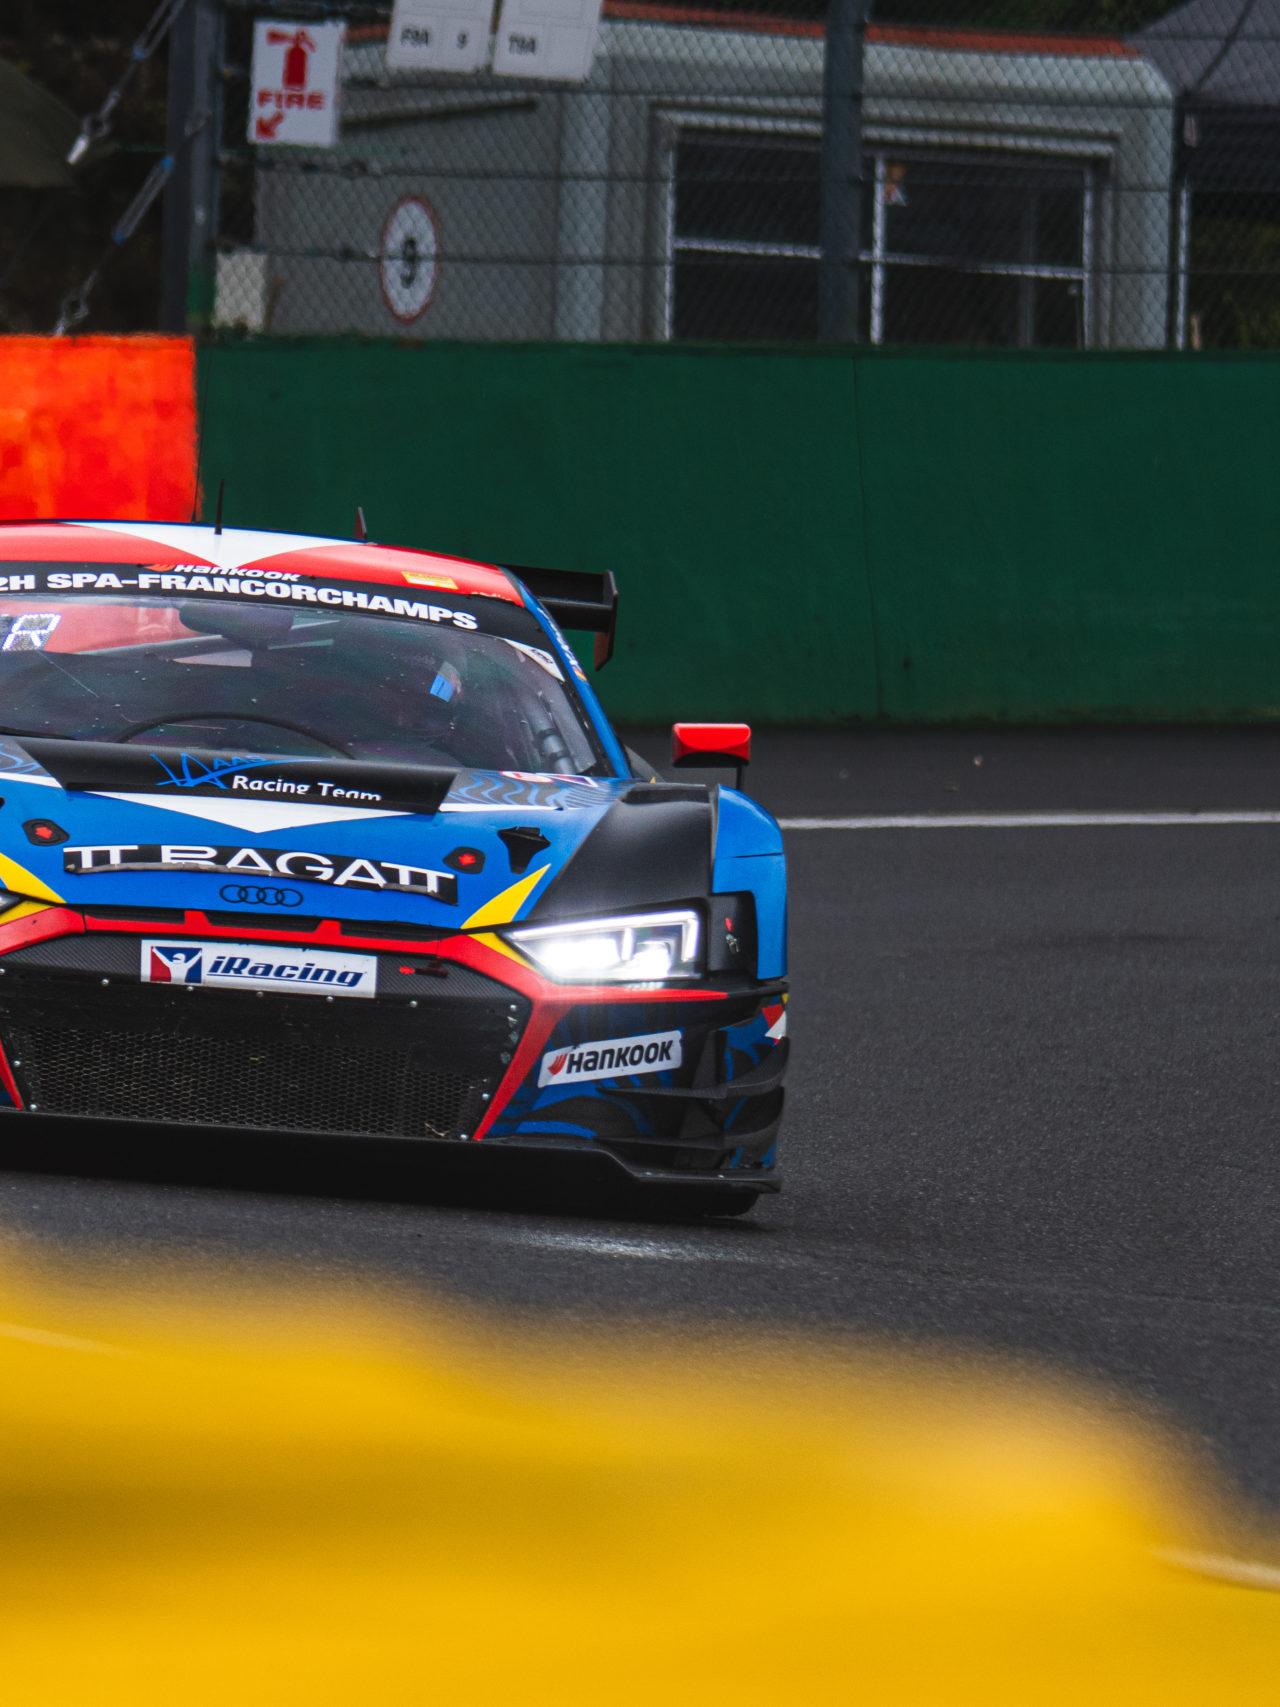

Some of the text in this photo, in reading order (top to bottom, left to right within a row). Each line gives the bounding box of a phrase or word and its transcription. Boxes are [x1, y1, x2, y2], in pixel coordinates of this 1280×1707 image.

[256, 89, 325, 111] FIRE
[46, 573, 479, 630] SPA-FRANCORCHAMPS
[231, 775, 312, 795] Racing
[206, 955, 364, 988] iRacing
